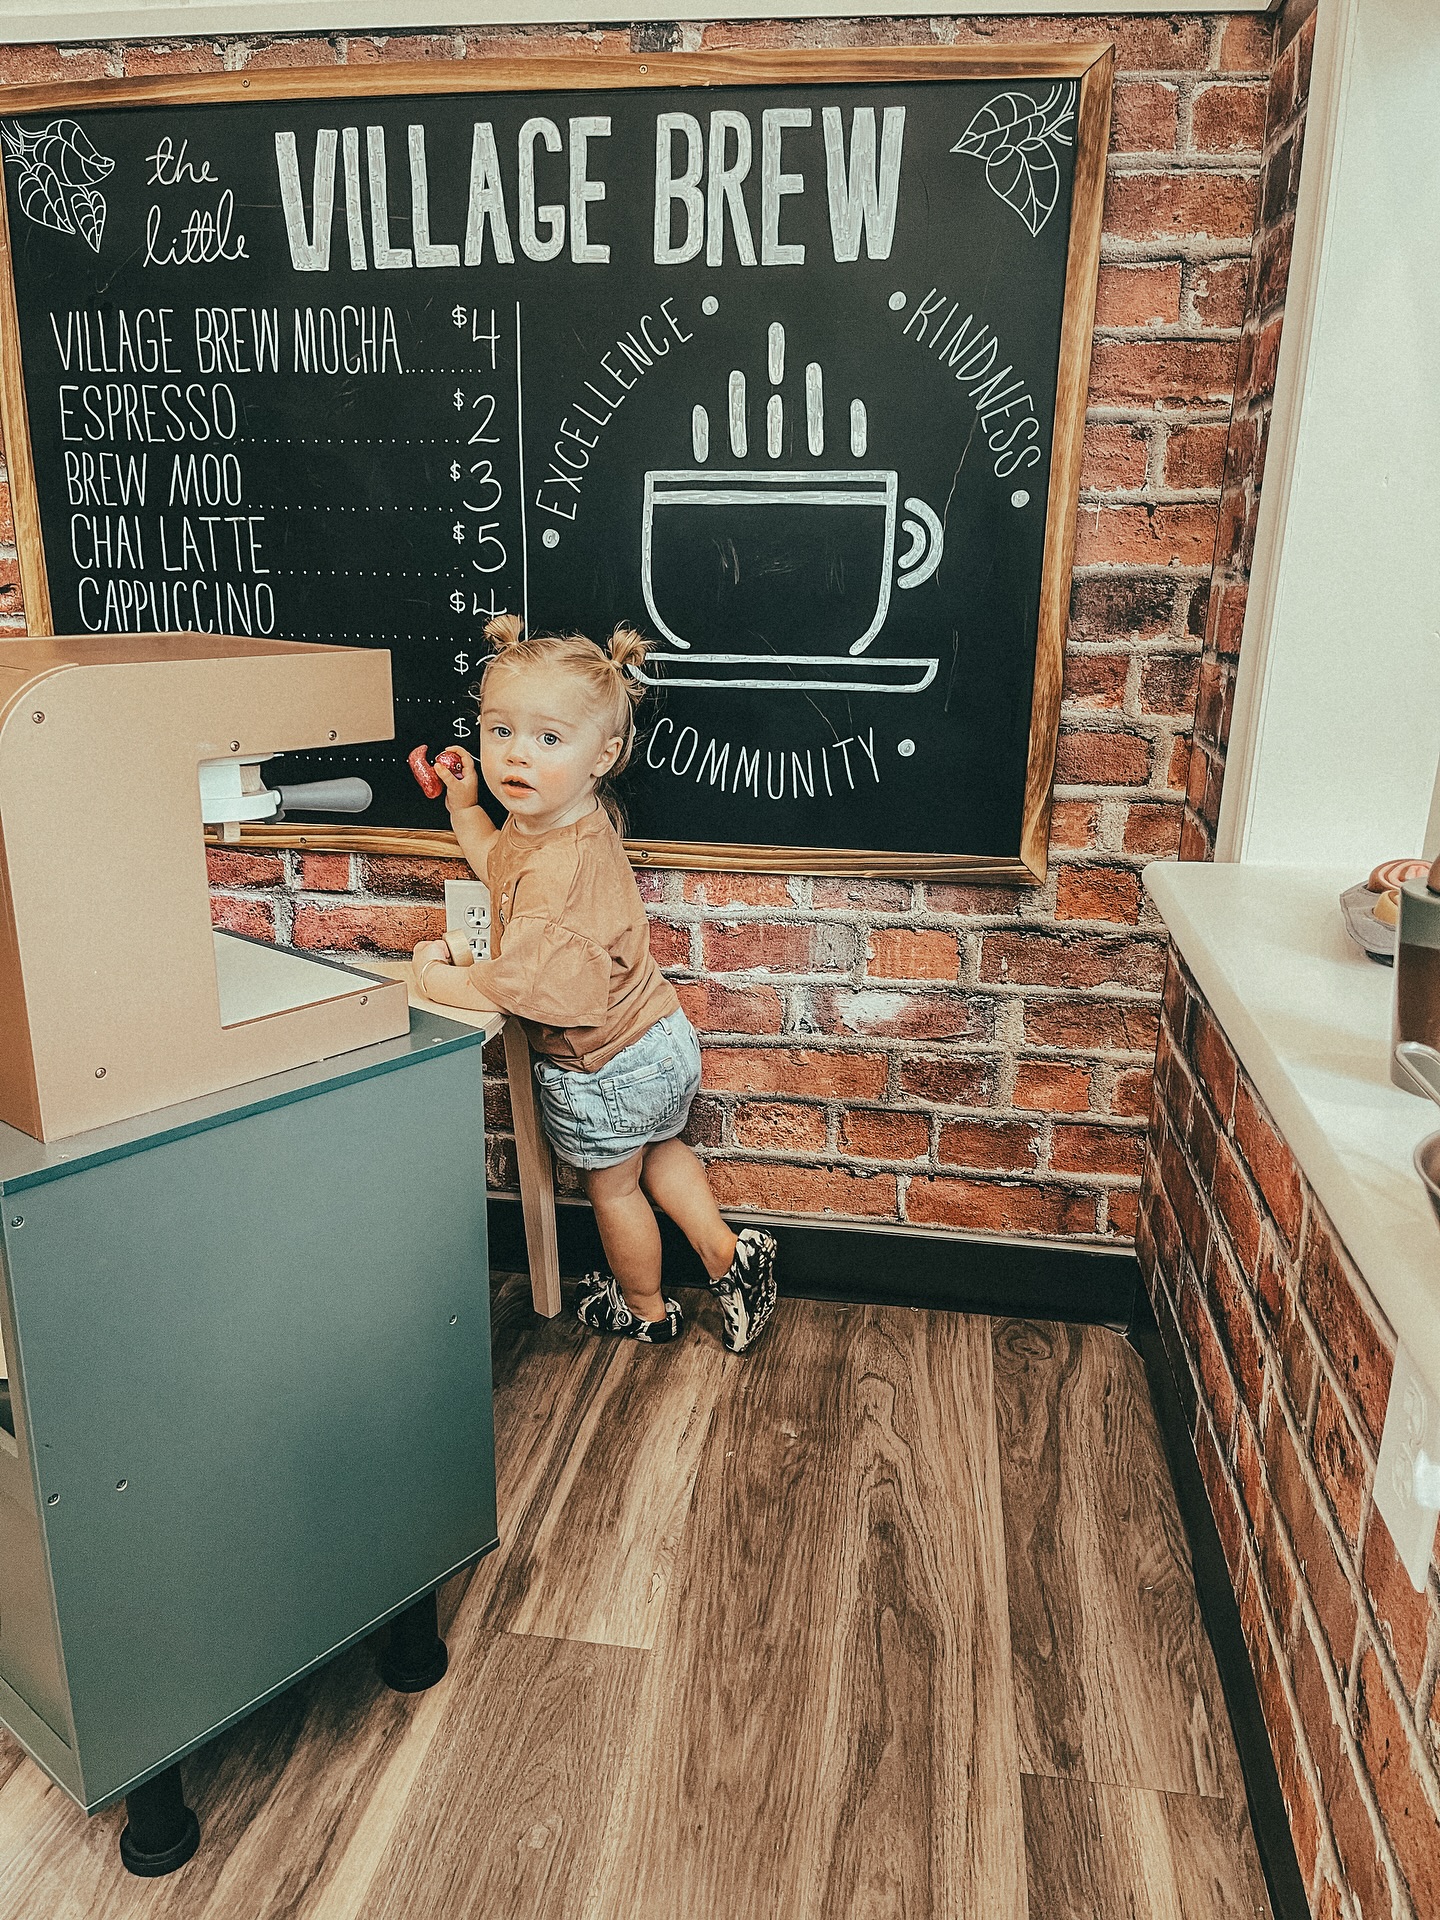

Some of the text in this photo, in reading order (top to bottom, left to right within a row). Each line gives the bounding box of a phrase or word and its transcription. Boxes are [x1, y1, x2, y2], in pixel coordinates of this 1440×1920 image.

[145, 137, 219, 186] the
[274, 106, 906, 272] VILLAGE BREW
[142, 189, 250, 268] little
[50, 308, 182, 373] VILLAGE
[195, 308, 279, 373] BREW
[452, 304, 501, 370] $4
[59, 383, 501, 445] ESPRESSO $2
[536, 297, 694, 520] EXCELLENCE
[903, 288, 1041, 478] KINDNESS
[64, 451, 502, 512] BREW MOO $3
[71, 513, 507, 574] CHAI LATTE $5
[78, 577, 275, 635] CAPPUCCINO
[646, 718, 880, 800] COMMUNITY
